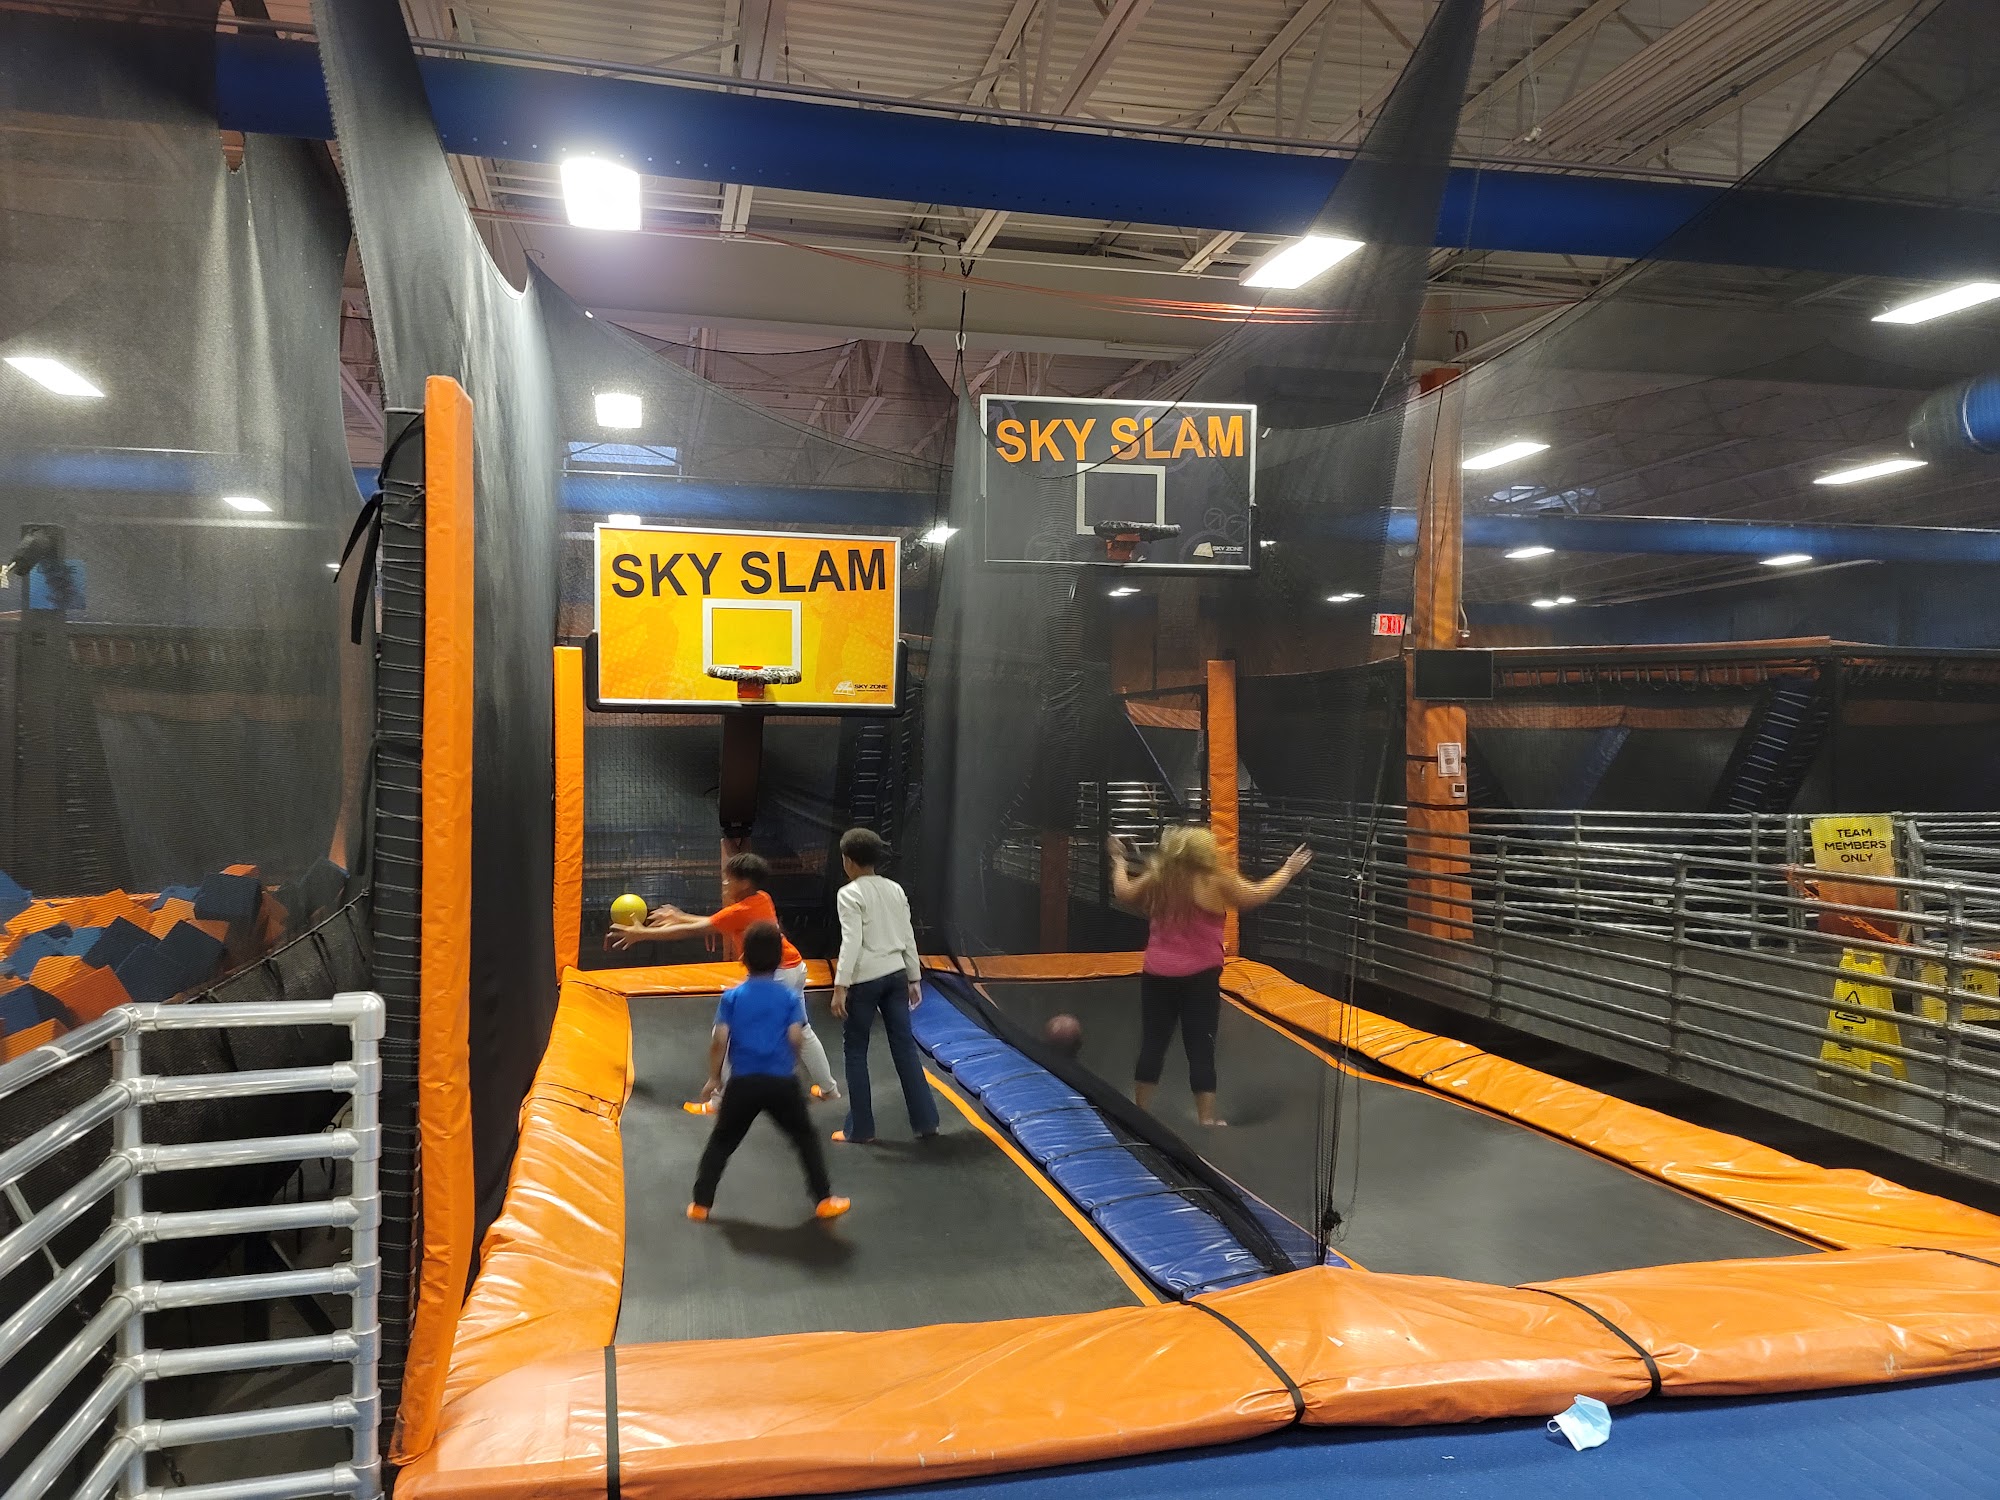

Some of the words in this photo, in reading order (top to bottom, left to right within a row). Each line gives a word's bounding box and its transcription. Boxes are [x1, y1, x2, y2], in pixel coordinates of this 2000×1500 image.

[996, 418, 1097, 463] SKY
[1110, 415, 1244, 461] SLAM
[611, 552, 723, 598] SKY
[740, 548, 887, 595] SLAM
[1836, 828, 1872, 838] TEAM
[1824, 840, 1887, 851] MEMBERS
[1841, 853, 1873, 863] ONLY
